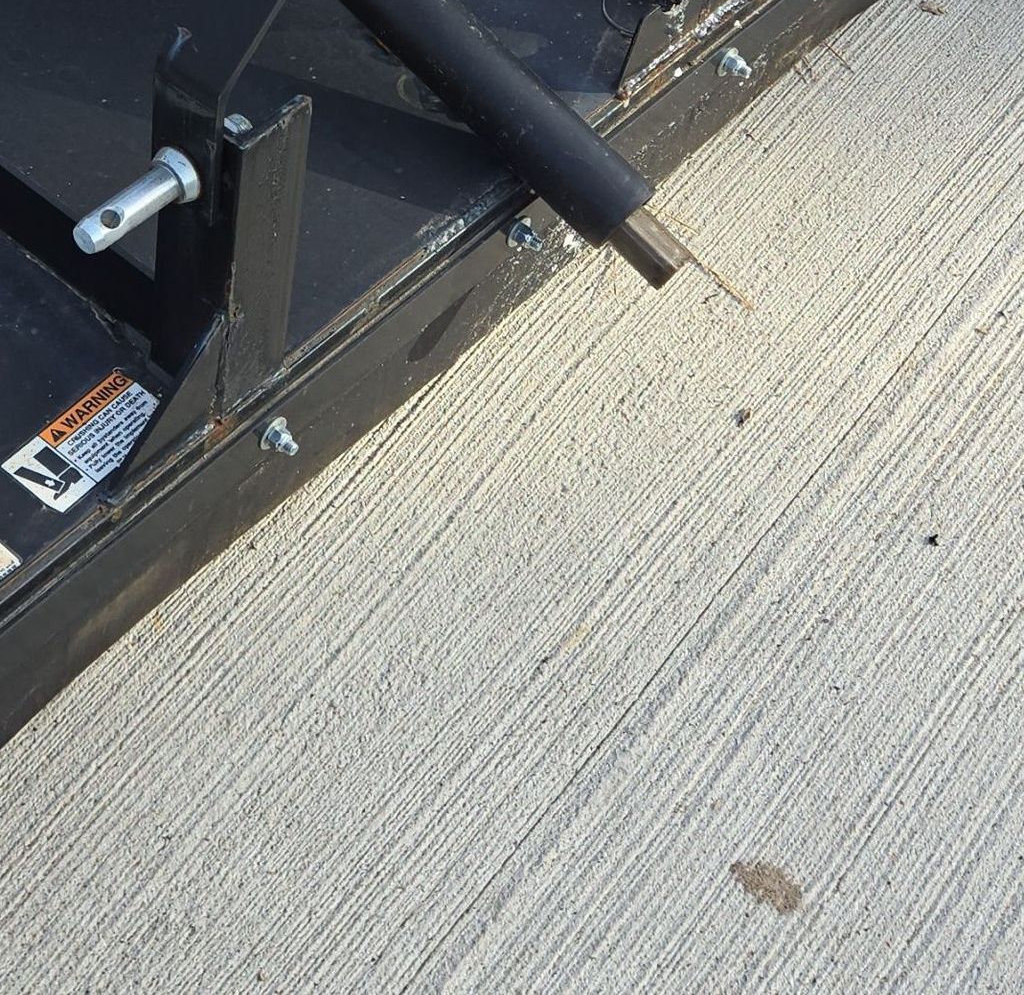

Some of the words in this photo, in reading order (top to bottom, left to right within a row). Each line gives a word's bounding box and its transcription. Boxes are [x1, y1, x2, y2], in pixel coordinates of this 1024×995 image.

[62, 375, 127, 430] WARNING
[66, 418, 99, 445] CRUSHING
[97, 407, 112, 420] CAN
[110, 390, 132, 409] CAUSE
[66, 432, 95, 456] SERIOUS
[92, 413, 117, 434] INJURY
[114, 406, 126, 416] OR
[124, 390, 145, 408] DEATH
